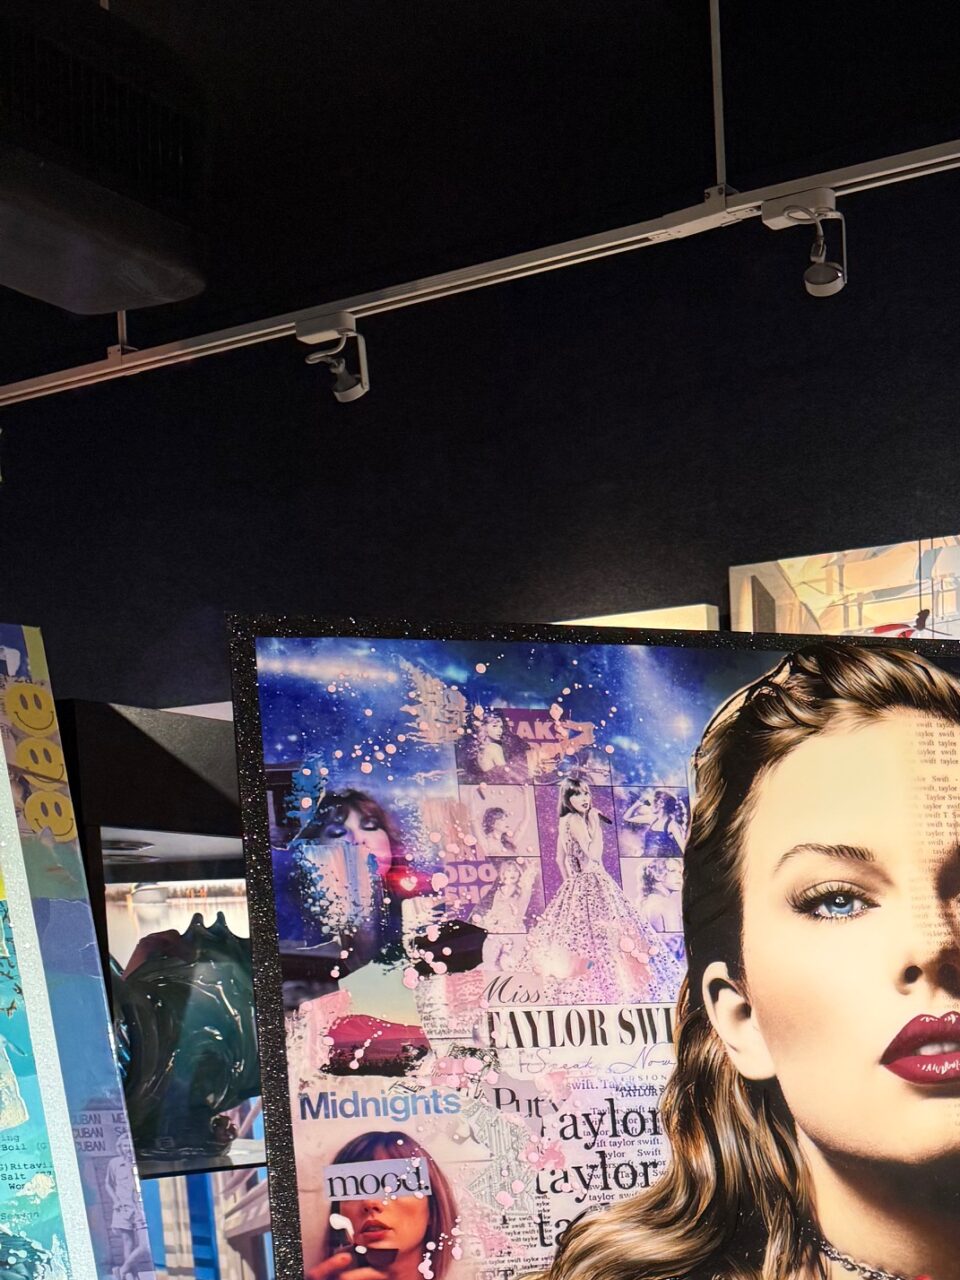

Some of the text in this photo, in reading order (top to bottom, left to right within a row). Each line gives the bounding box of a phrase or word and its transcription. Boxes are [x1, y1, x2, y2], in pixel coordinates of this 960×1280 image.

[482, 975, 541, 1004] Miss
[488, 1008, 609, 1049] TAYLOR
[300, 1090, 461, 1122] Midnights
[541, 1098, 663, 1150] aylor
[599, 1149, 662, 1160] aylor Swift
[609, 1138, 635, 1150] taylor
[637, 1137, 663, 1146] swift.
[1, 1172, 27, 1181] Salt
[327, 1166, 430, 1198] mood.
[536, 1150, 658, 1204] taylor
[588, 1192, 615, 1203] taylor
